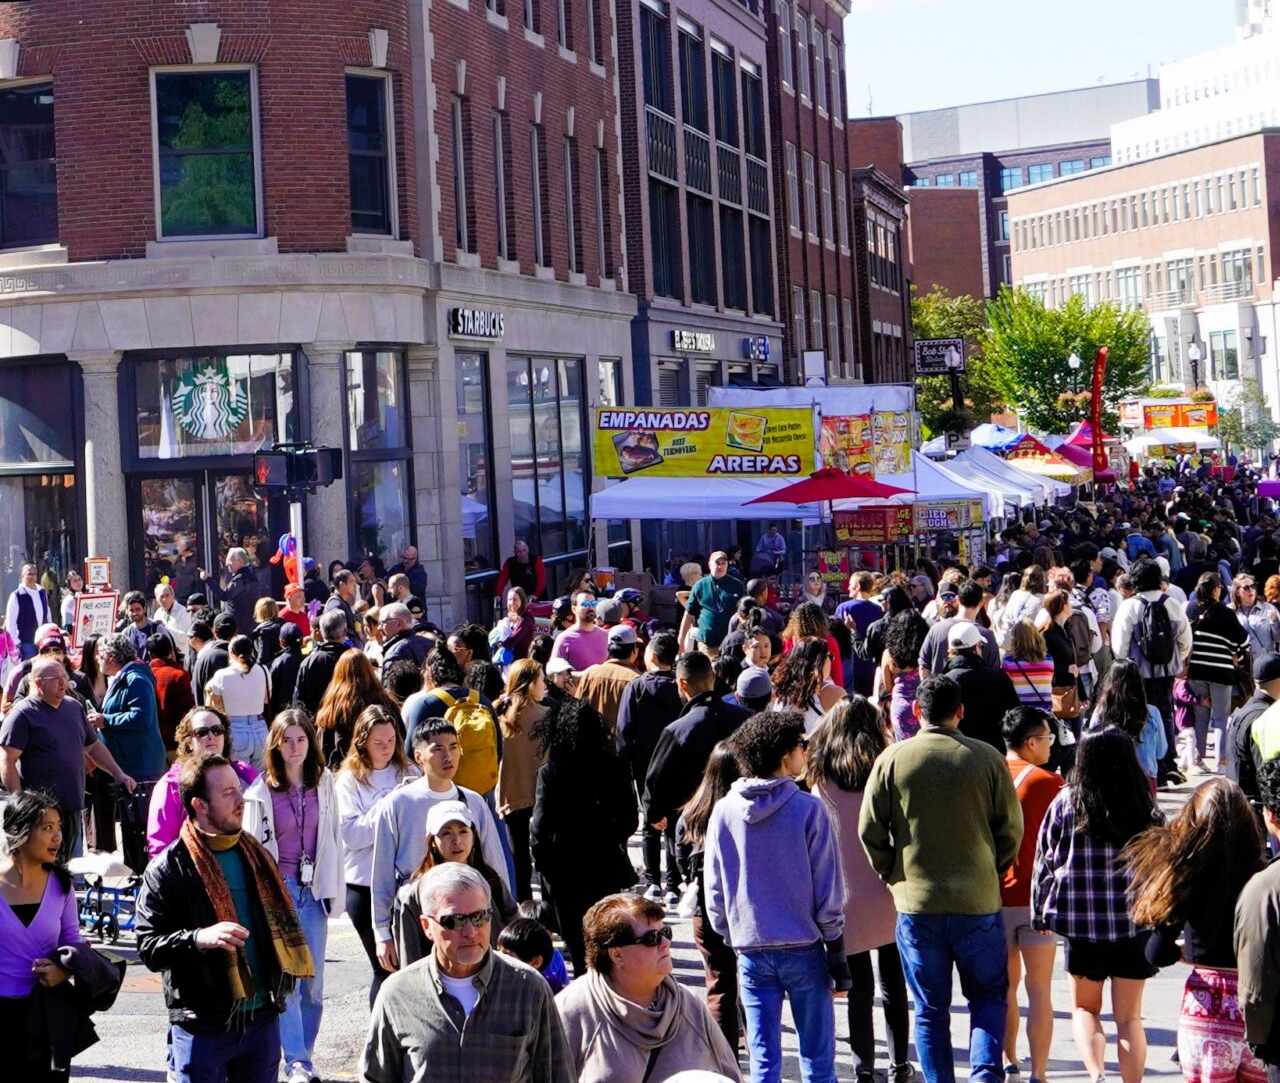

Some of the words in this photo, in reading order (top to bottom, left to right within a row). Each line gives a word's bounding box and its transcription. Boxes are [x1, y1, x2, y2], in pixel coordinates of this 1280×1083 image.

[457, 308, 505, 337] STARBUCKS
[599, 411, 709, 429] EMPANADAS
[663, 445, 697, 456] TURNOVERS
[709, 455, 800, 472] AREPAS
[82, 602, 94, 610] FREE
